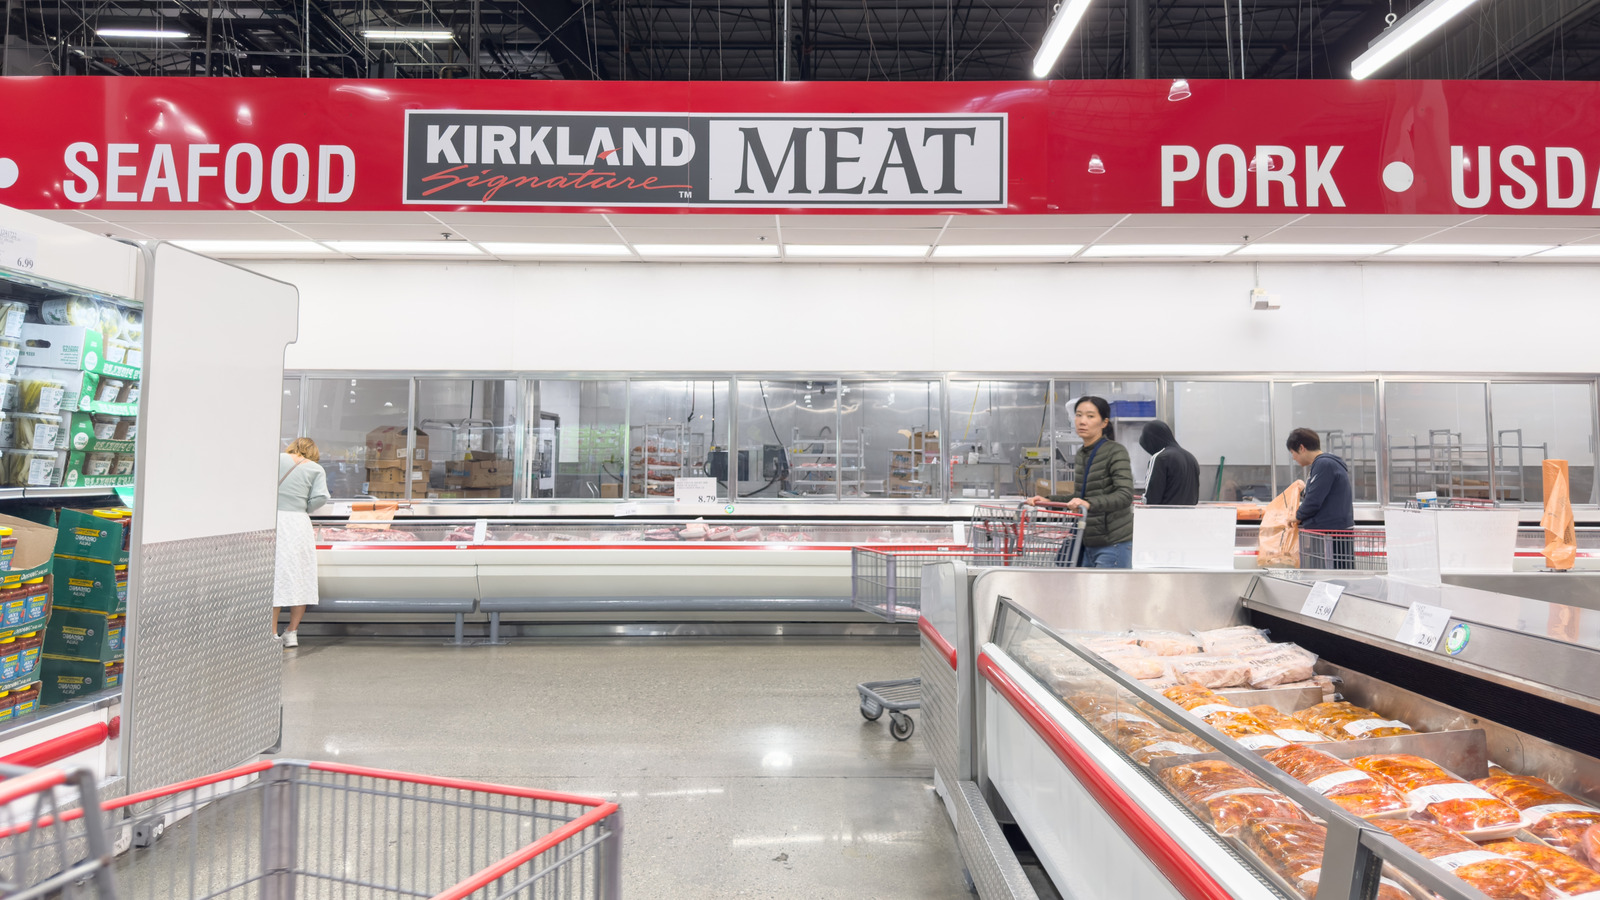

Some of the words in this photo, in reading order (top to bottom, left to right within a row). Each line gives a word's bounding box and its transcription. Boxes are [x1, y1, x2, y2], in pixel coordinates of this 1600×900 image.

[426, 124, 696, 167] KIRKLAND
[734, 126, 977, 195] MEAT
[63, 141, 356, 204] SEAFOOD
[422, 164, 693, 203] Signature
[1160, 143, 1347, 209] PORK
[1450, 144, 1600, 210] USD
[678, 190, 693, 199] TM
[17, 257, 34, 269] 6.99
[698, 495, 716, 503] 8.79
[1315, 605, 1332, 616] 15.99
